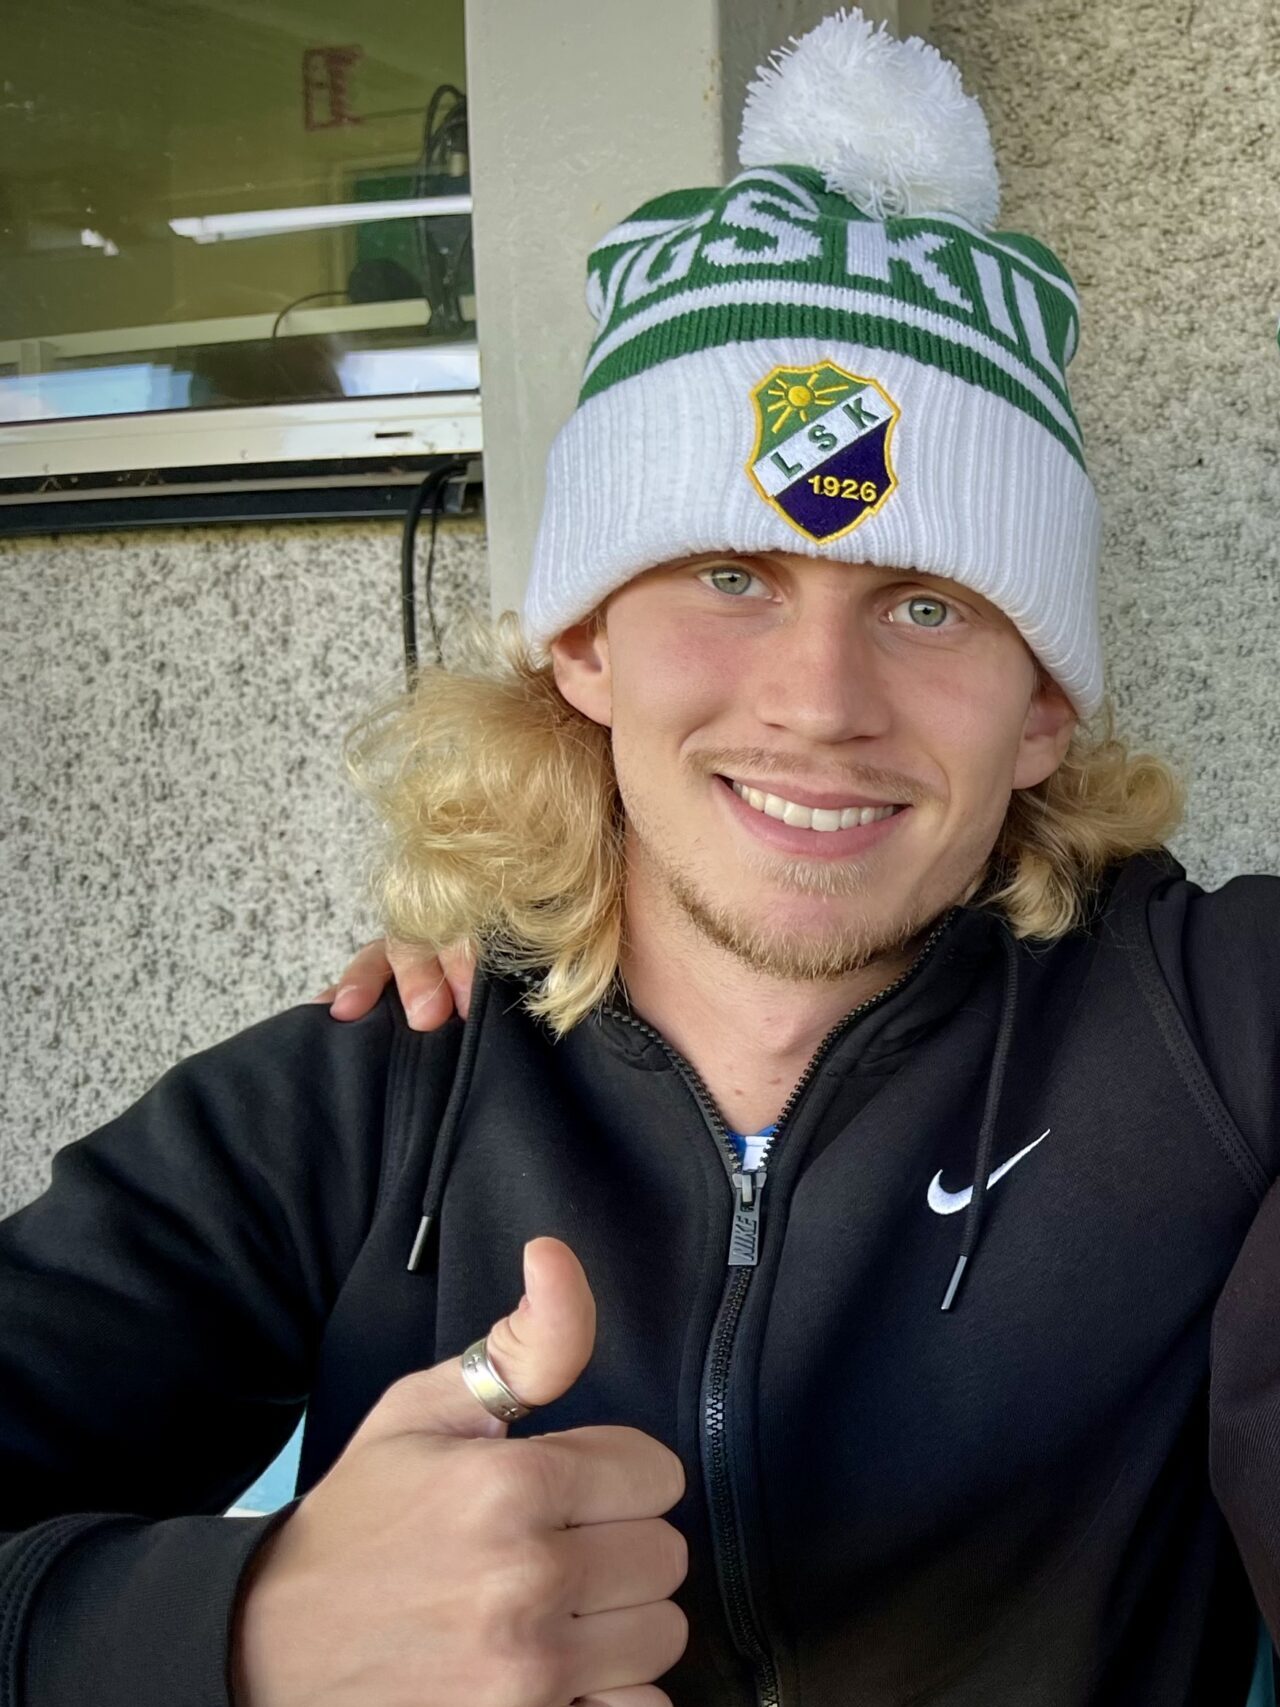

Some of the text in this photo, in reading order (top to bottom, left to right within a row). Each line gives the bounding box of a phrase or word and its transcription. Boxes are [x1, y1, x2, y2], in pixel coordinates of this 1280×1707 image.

[769, 397, 880, 479] LSK
[807, 474, 878, 502] 1926
[731, 1214, 757, 1262] NIKE
